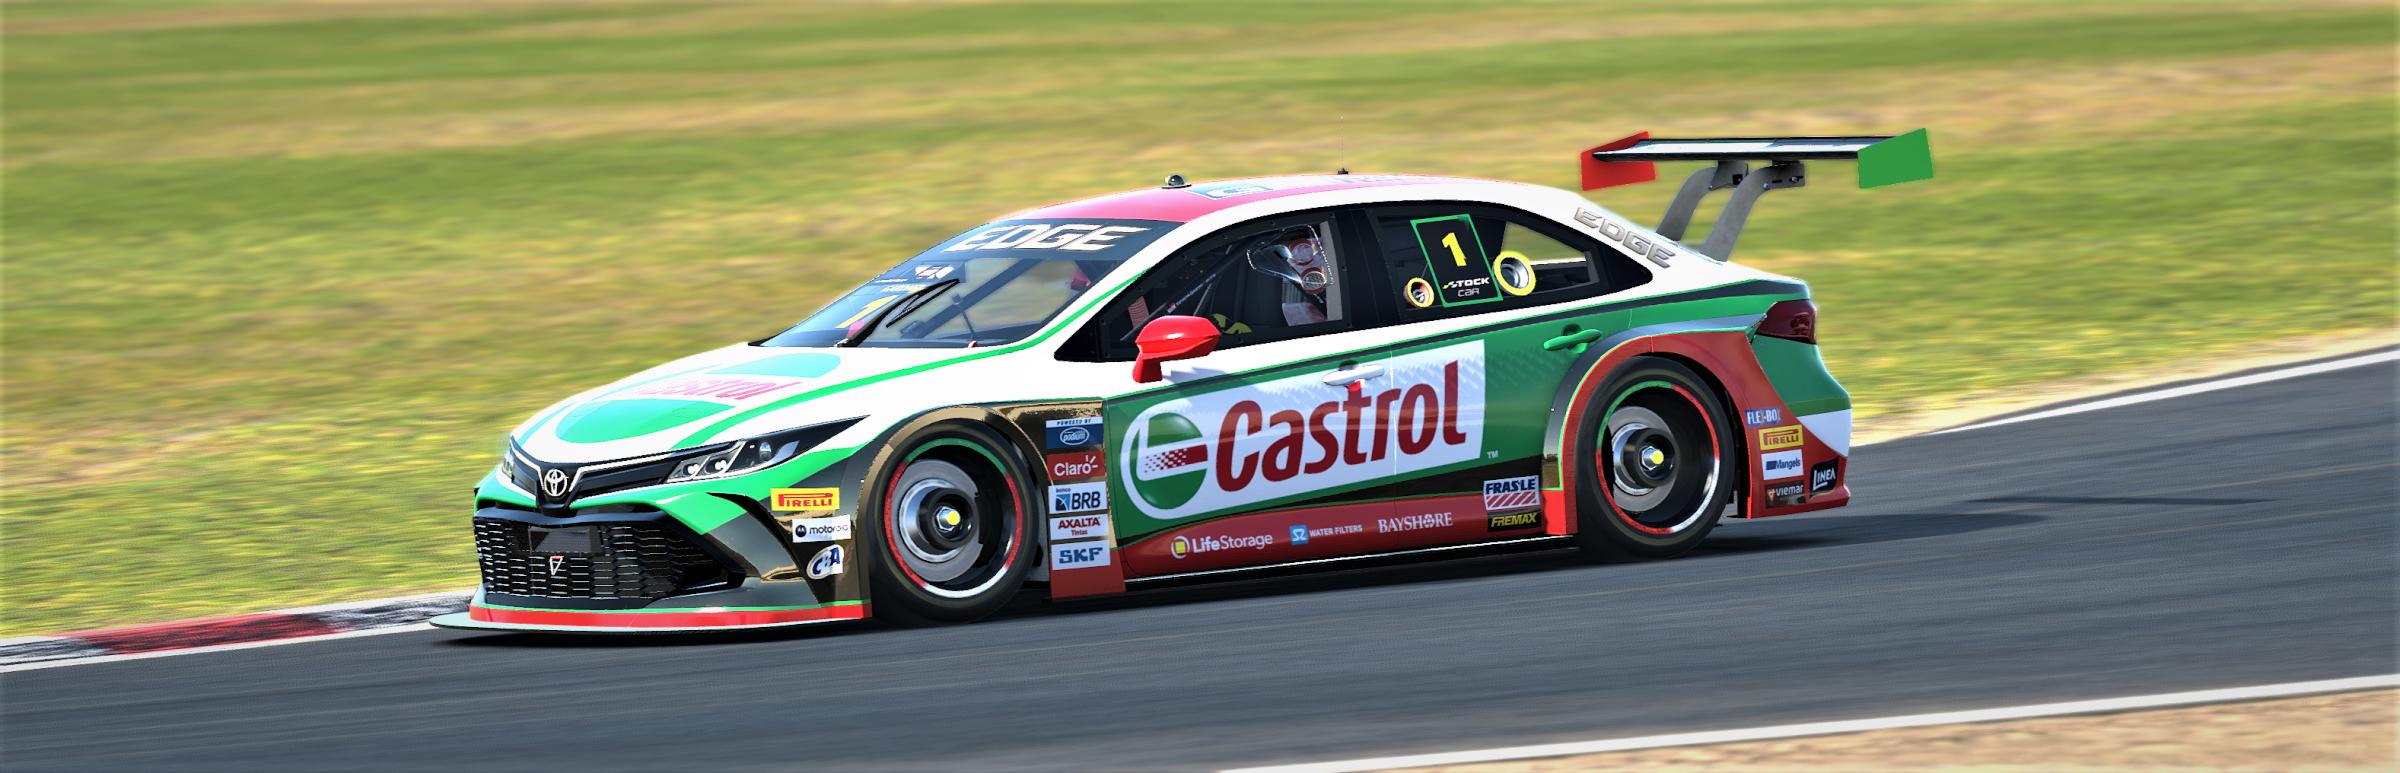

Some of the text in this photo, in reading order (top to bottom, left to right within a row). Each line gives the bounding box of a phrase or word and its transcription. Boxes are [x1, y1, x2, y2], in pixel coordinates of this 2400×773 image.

[943, 223, 1152, 252] EDGE
[1573, 207, 1676, 269] EDGE
[1441, 232, 1467, 267] 1
[1442, 277, 1490, 289] STOCK
[1215, 360, 1467, 492] Castrol
[1763, 429, 1799, 446] PIRELLI
[1054, 462, 1092, 477] Claro
[1813, 468, 1836, 491] LINEA
[778, 493, 833, 507] PIRELLI
[1071, 491, 1101, 510] BRB
[1057, 517, 1101, 529] AXALTA
[1378, 512, 1453, 534] BAYSHORE
[1491, 512, 1537, 527] FREMAX
[1309, 525, 1363, 537] WATER FILTERS
[1059, 547, 1103, 564] SKF
